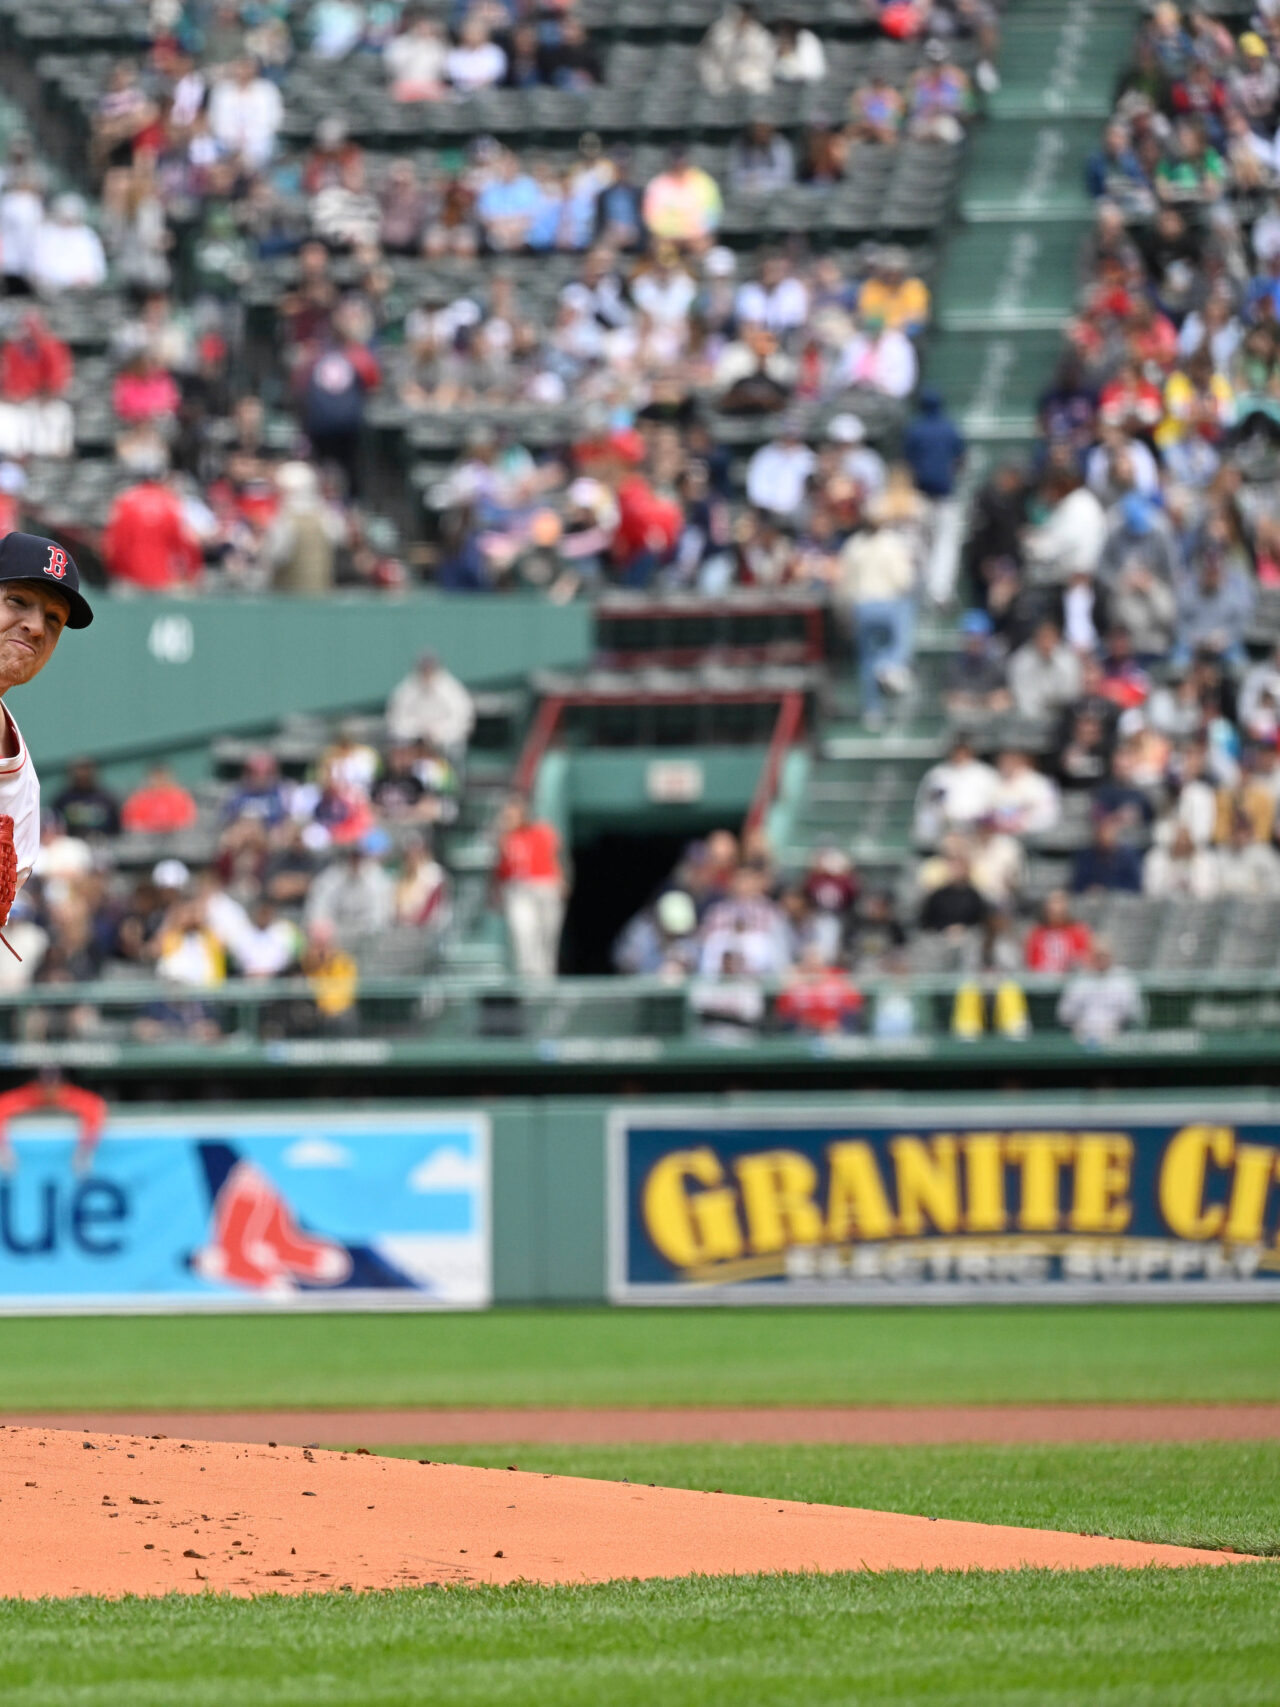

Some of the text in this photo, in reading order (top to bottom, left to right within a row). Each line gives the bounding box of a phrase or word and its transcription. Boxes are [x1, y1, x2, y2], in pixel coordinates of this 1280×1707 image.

[43, 545, 67, 579] B
[642, 1122, 1280, 1269] GRANITE CI
